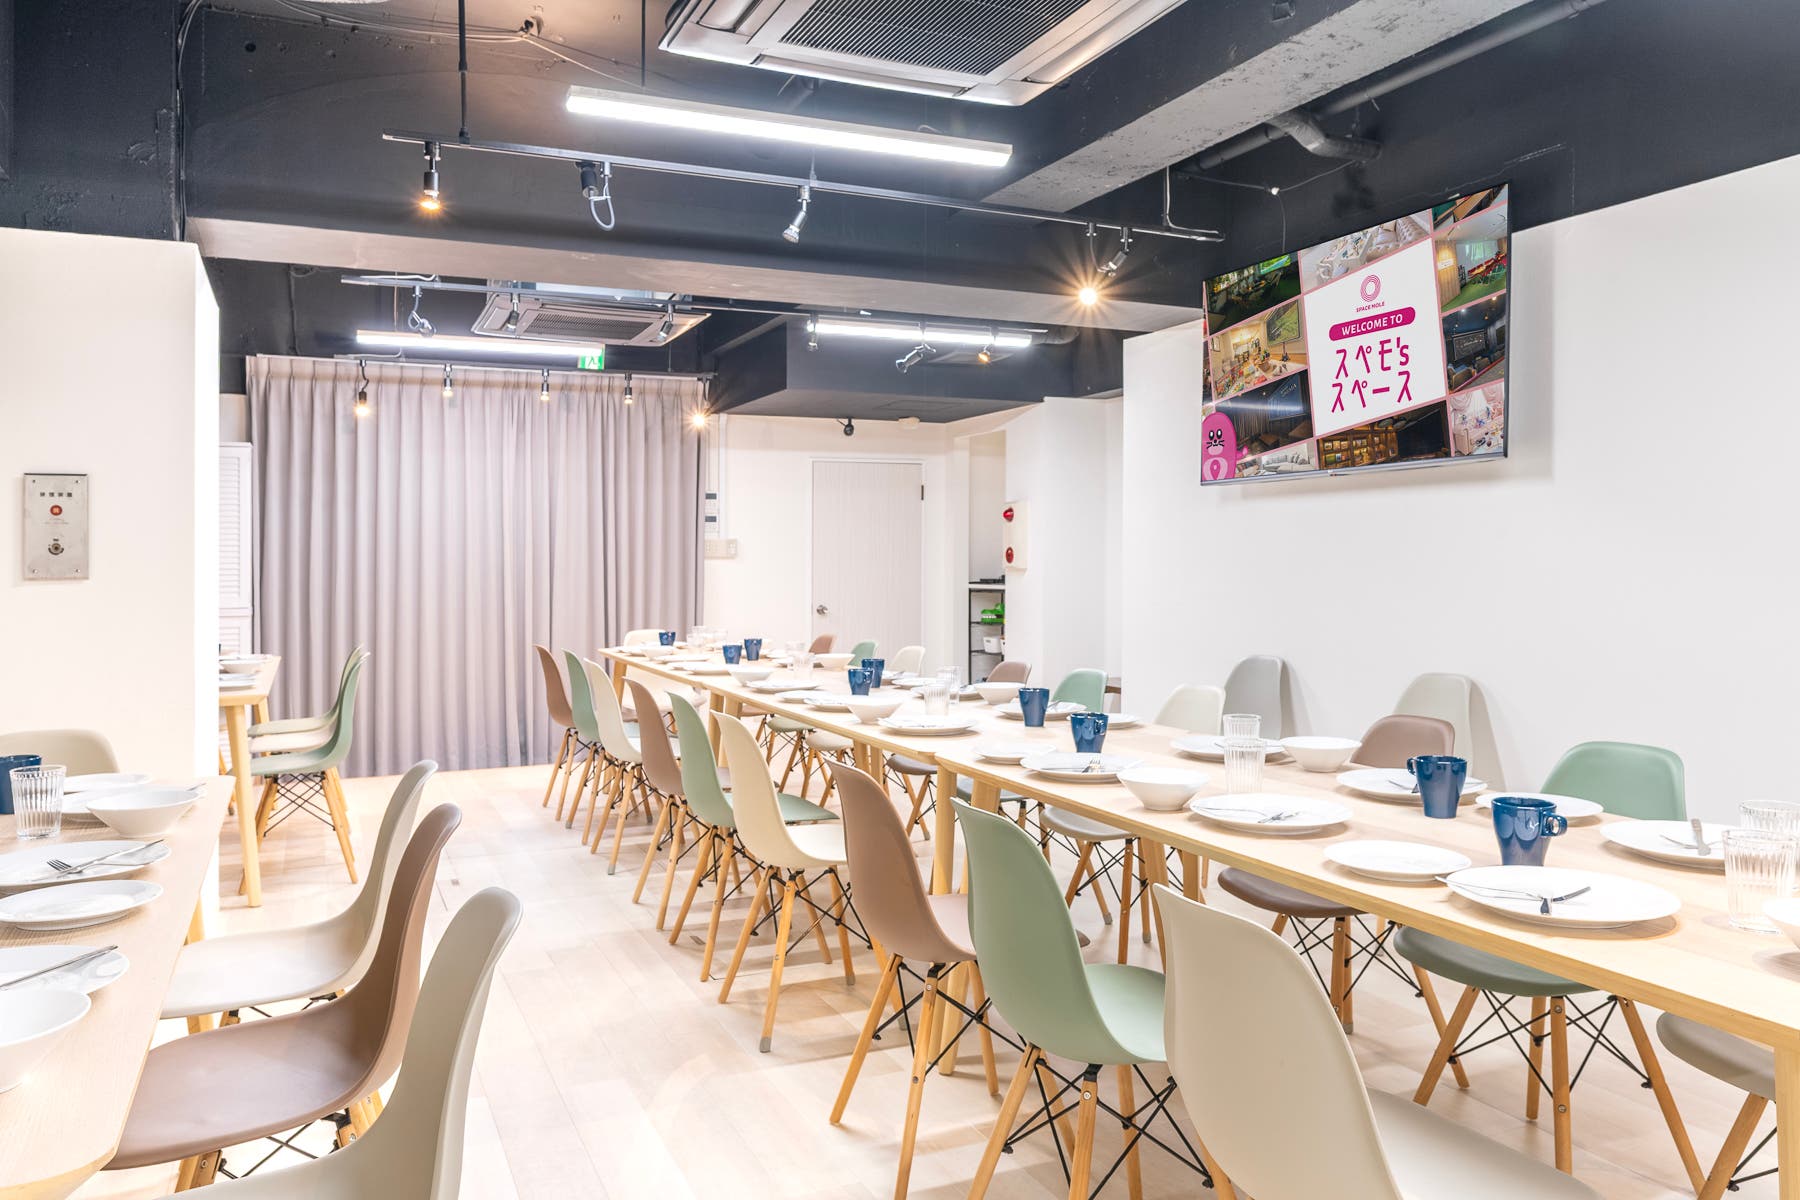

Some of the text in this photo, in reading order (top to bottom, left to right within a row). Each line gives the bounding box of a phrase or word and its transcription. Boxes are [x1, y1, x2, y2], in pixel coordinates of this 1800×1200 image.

[1356, 301, 1385, 313] SPACE MOLE
[1341, 314, 1403, 335] WELCOME TO
[1331, 370, 1412, 413] スペース
